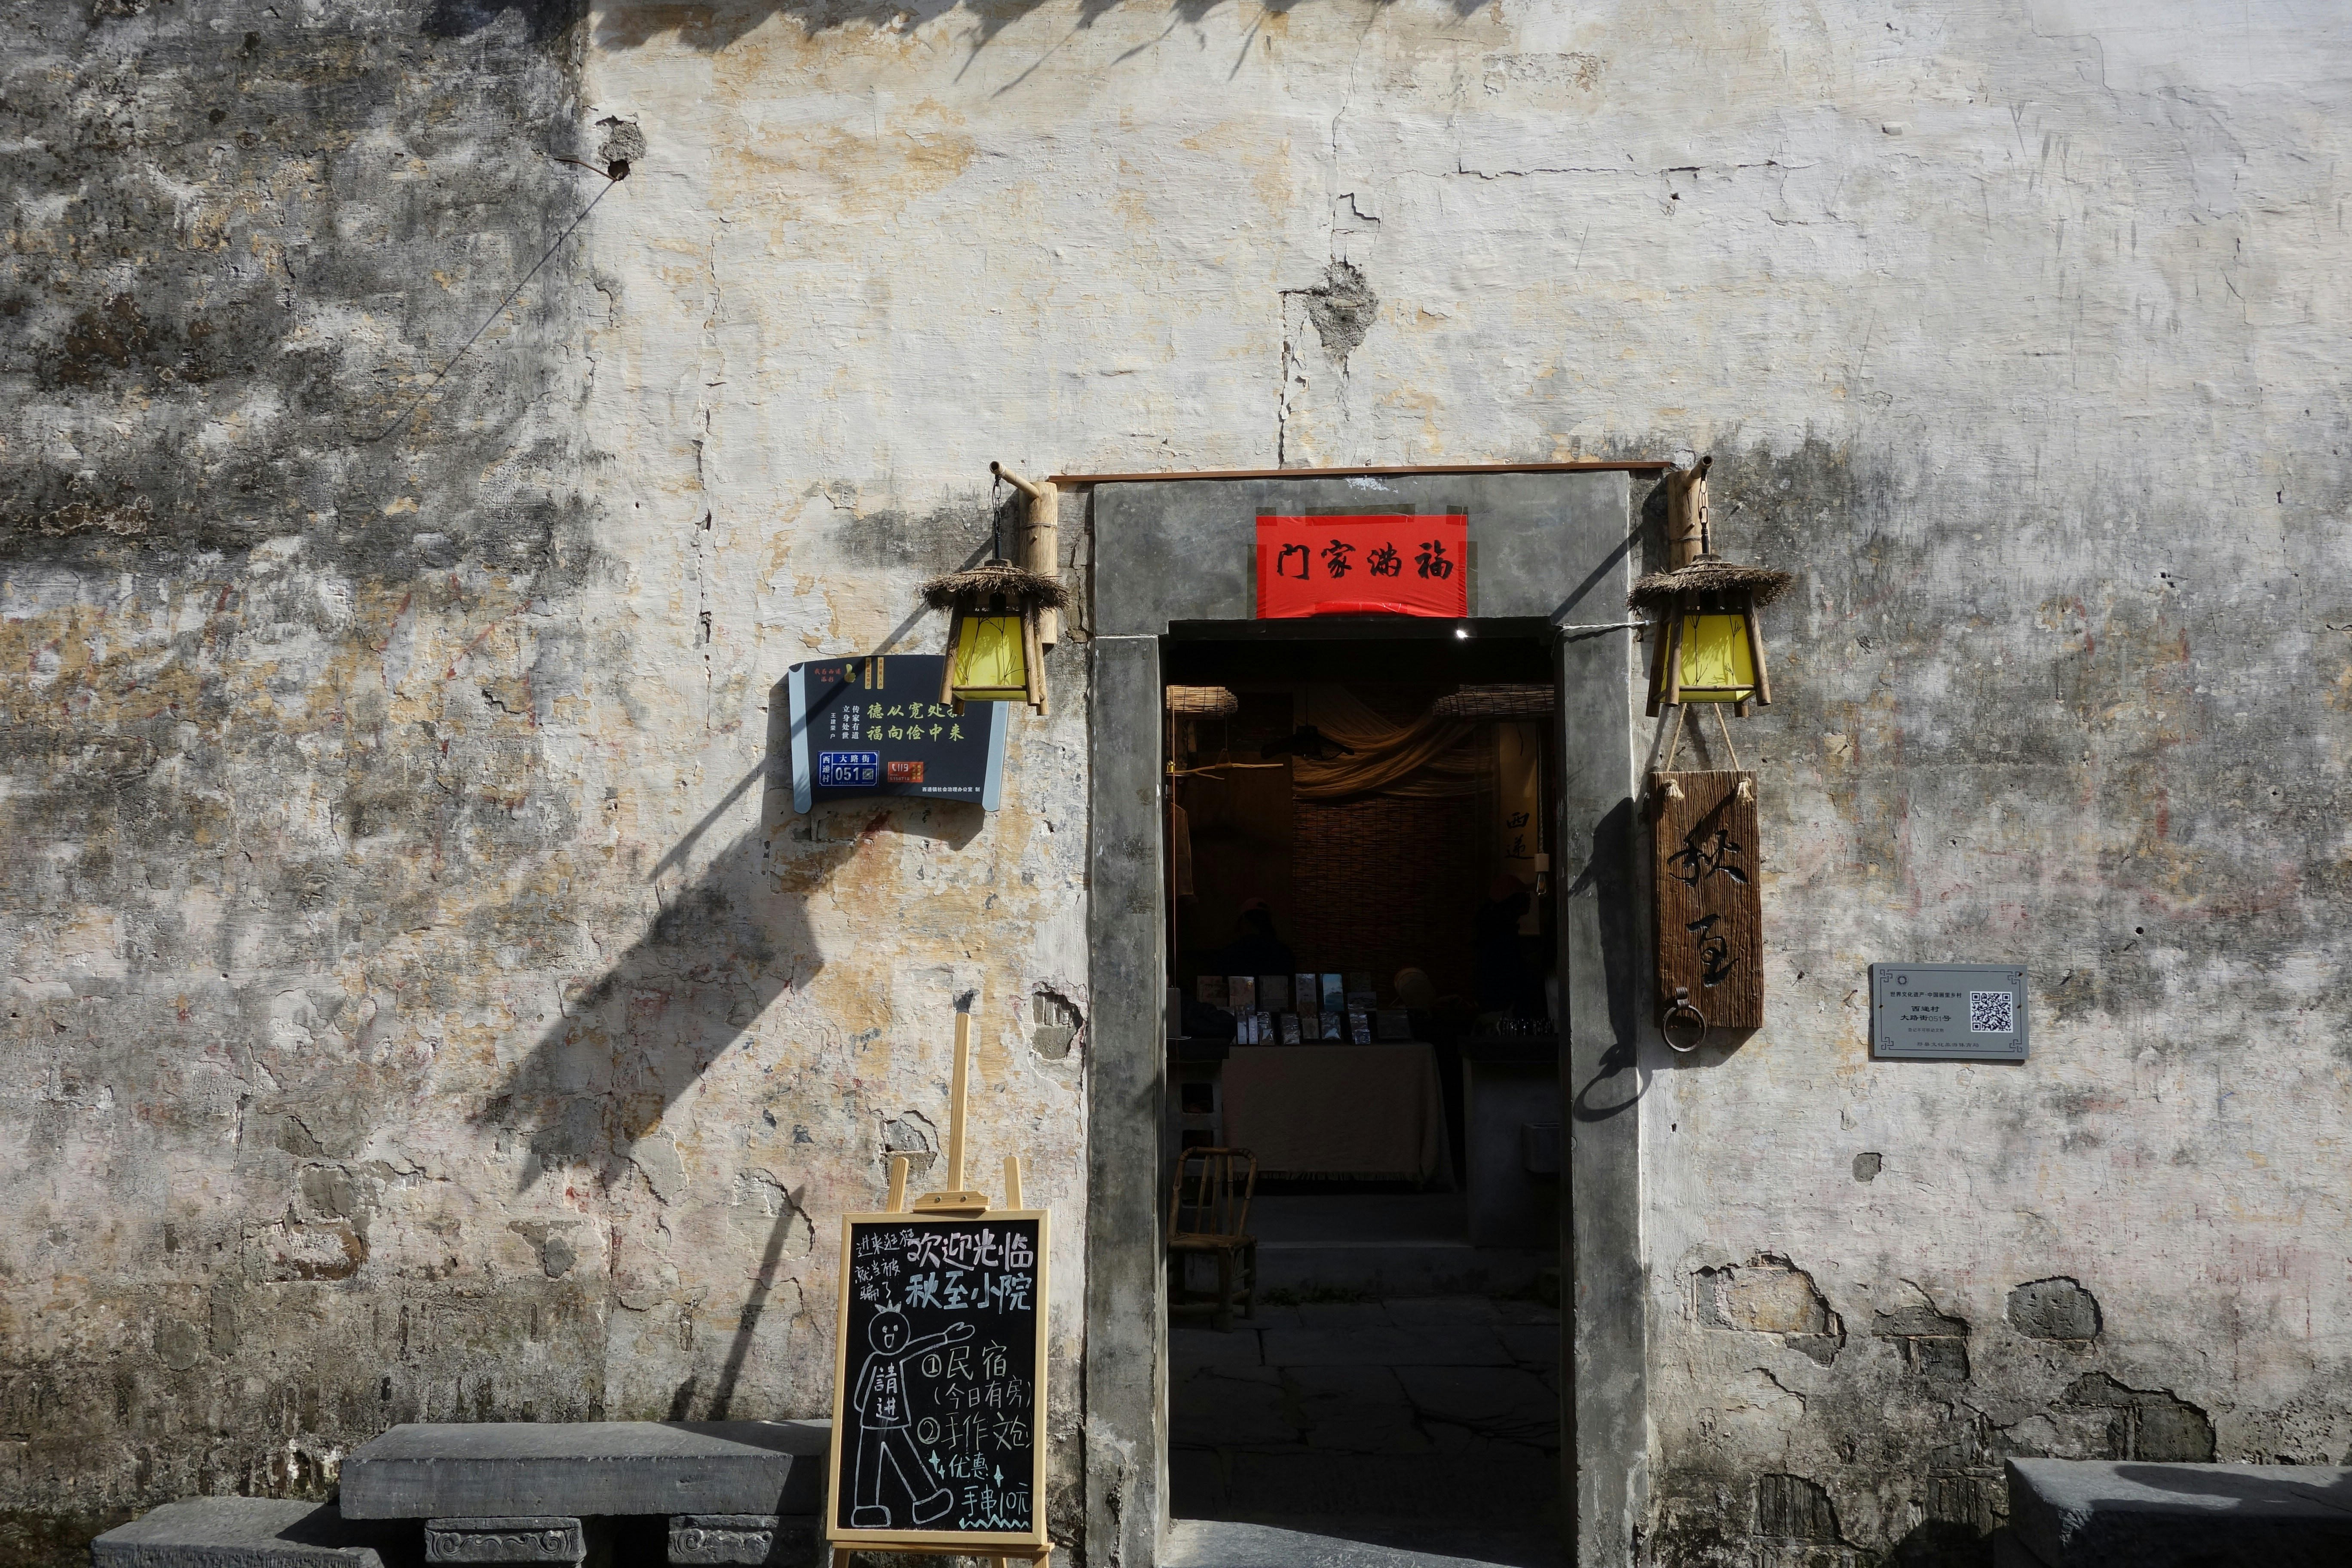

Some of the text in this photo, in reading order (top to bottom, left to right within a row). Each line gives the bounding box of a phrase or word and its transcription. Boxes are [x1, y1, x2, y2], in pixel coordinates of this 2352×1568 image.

[842, 705, 850, 739] 立身处世
[851, 705, 860, 739] 传家有道
[866, 723, 965, 742] 福向俭中来
[822, 756, 830, 783] 西递村
[835, 767, 859, 781] 051
[839, 754, 870, 763] 大路街
[1506, 812, 1535, 859] 西递
[906, 1228, 1034, 1271] 欢迎光临
[860, 1281, 891, 1301] 骗了
[905, 1271, 1032, 1314] 秋至小院
[948, 1452, 989, 1480] 优惠
[961, 1482, 1032, 1519] 手串10元
